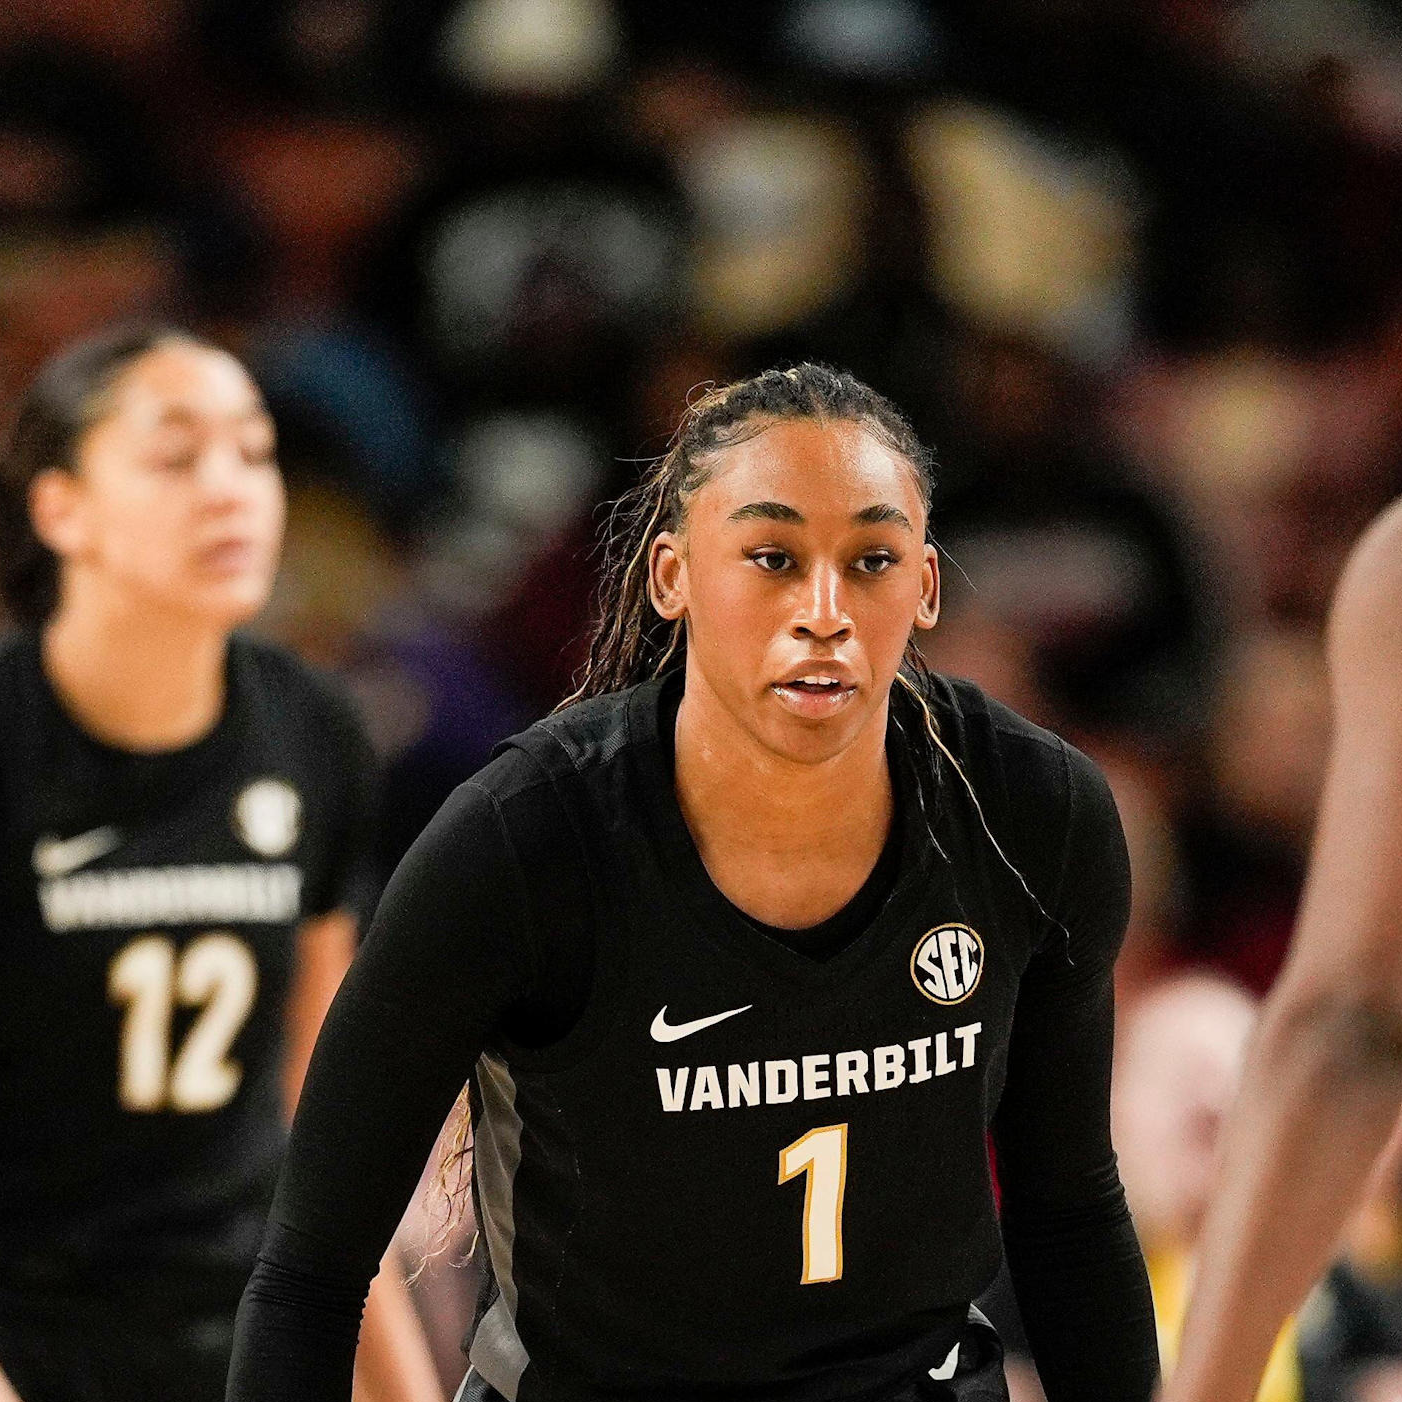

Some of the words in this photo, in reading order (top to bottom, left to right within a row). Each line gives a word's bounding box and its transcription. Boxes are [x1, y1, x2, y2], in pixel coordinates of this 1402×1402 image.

[106, 930, 260, 1114] 12
[916, 929, 979, 1000] SEC
[655, 1021, 983, 1113] VANDERBILT
[777, 1122, 849, 1286] 1
